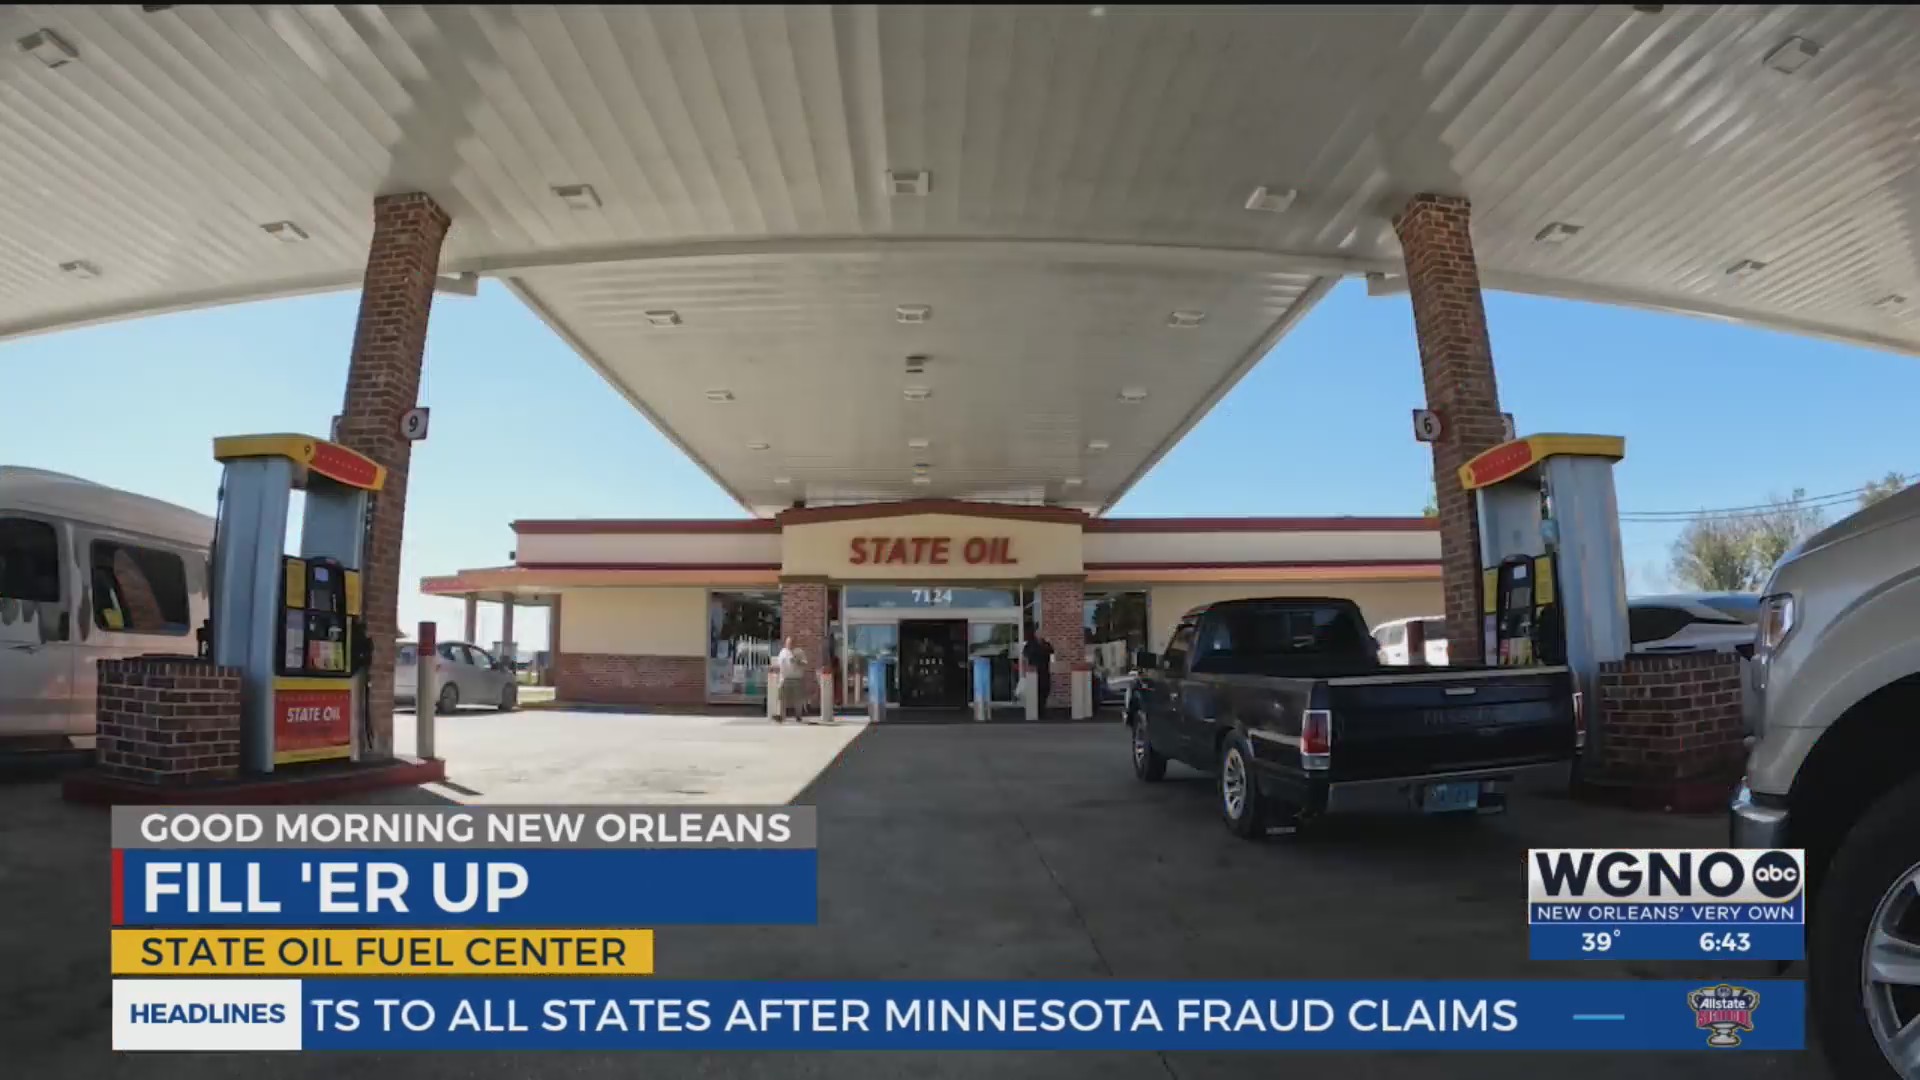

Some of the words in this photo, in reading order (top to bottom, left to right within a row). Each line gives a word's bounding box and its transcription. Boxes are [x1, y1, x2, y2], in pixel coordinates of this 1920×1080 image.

[409, 415, 419, 432] 9
[1423, 418, 1432, 434] 6
[849, 536, 951, 565] STATE
[963, 536, 1018, 565] OIL
[911, 588, 953, 605] 7124
[287, 706, 320, 723] STATE
[323, 705, 341, 722] OIL
